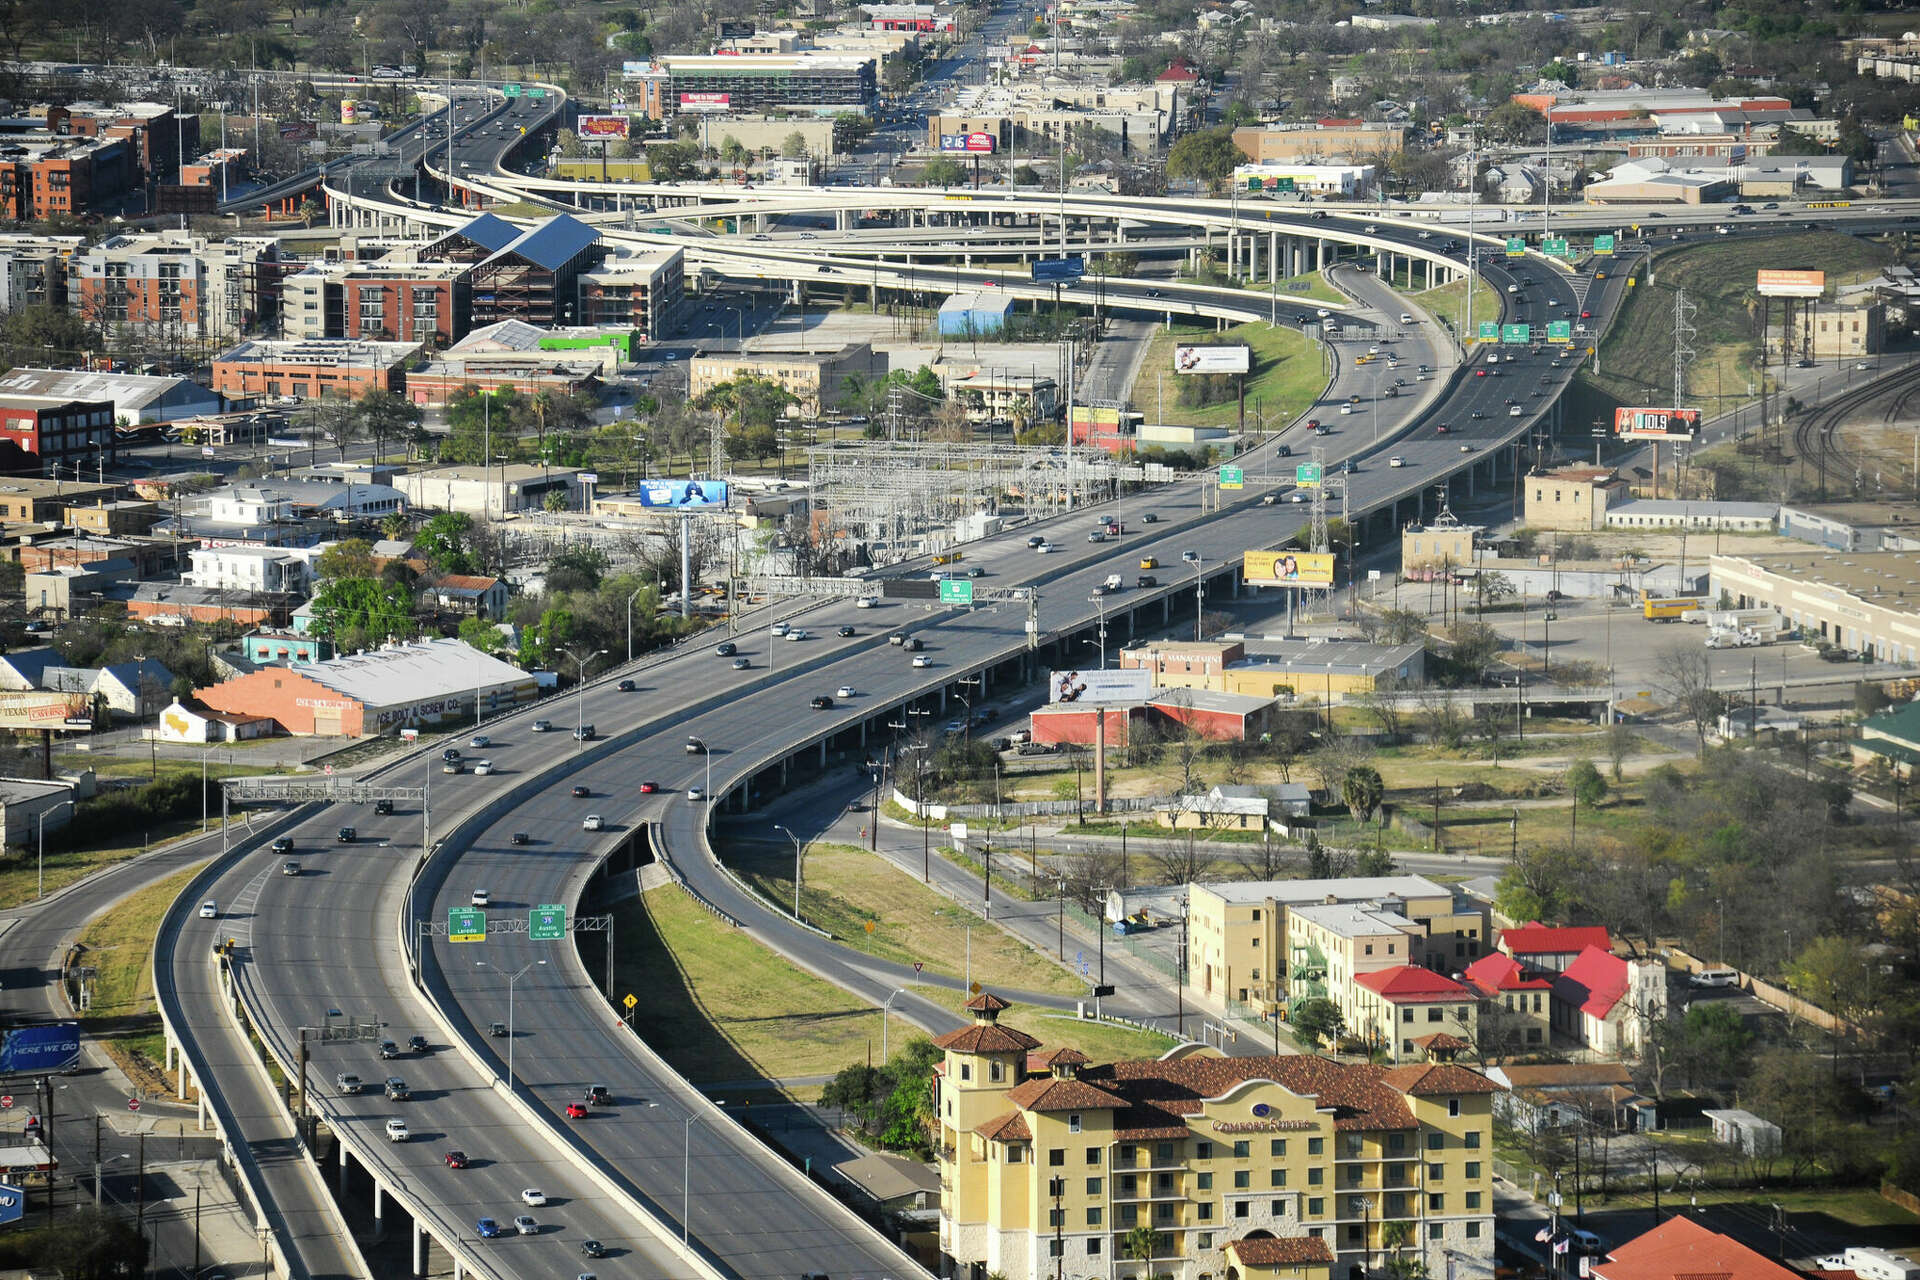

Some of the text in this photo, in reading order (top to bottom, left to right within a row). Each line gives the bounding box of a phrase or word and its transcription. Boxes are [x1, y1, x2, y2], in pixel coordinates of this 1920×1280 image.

[1645, 414, 1667, 430] 101.9
[1168, 655, 1221, 663] MANAGEMENT
[5, 707, 27, 716] TEXAS
[392, 708, 409, 721] BOLT
[420, 702, 446, 716] SCREW
[14, 1047, 40, 1055] HERE
[44, 1044, 59, 1052] WE
[61, 1043, 77, 1051] GO
